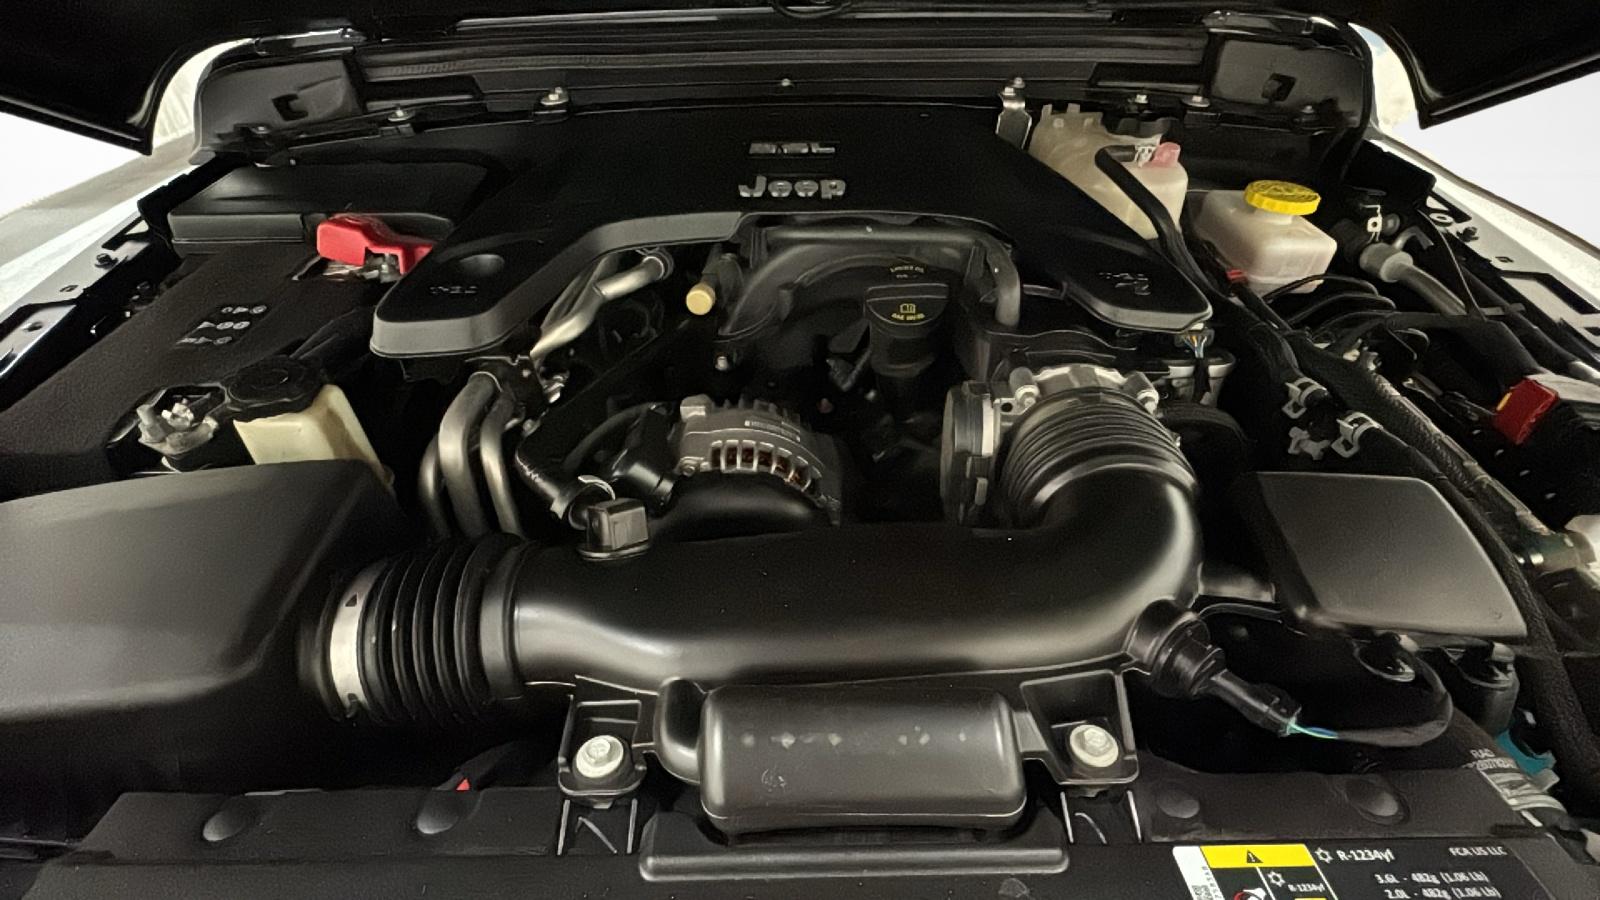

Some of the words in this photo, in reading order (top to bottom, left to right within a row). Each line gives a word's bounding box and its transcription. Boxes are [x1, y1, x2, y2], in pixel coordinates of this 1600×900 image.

[738, 175, 846, 200] Jeep
[1336, 848, 1395, 863] R-1234yf
[1448, 847, 1472, 856] FCA
